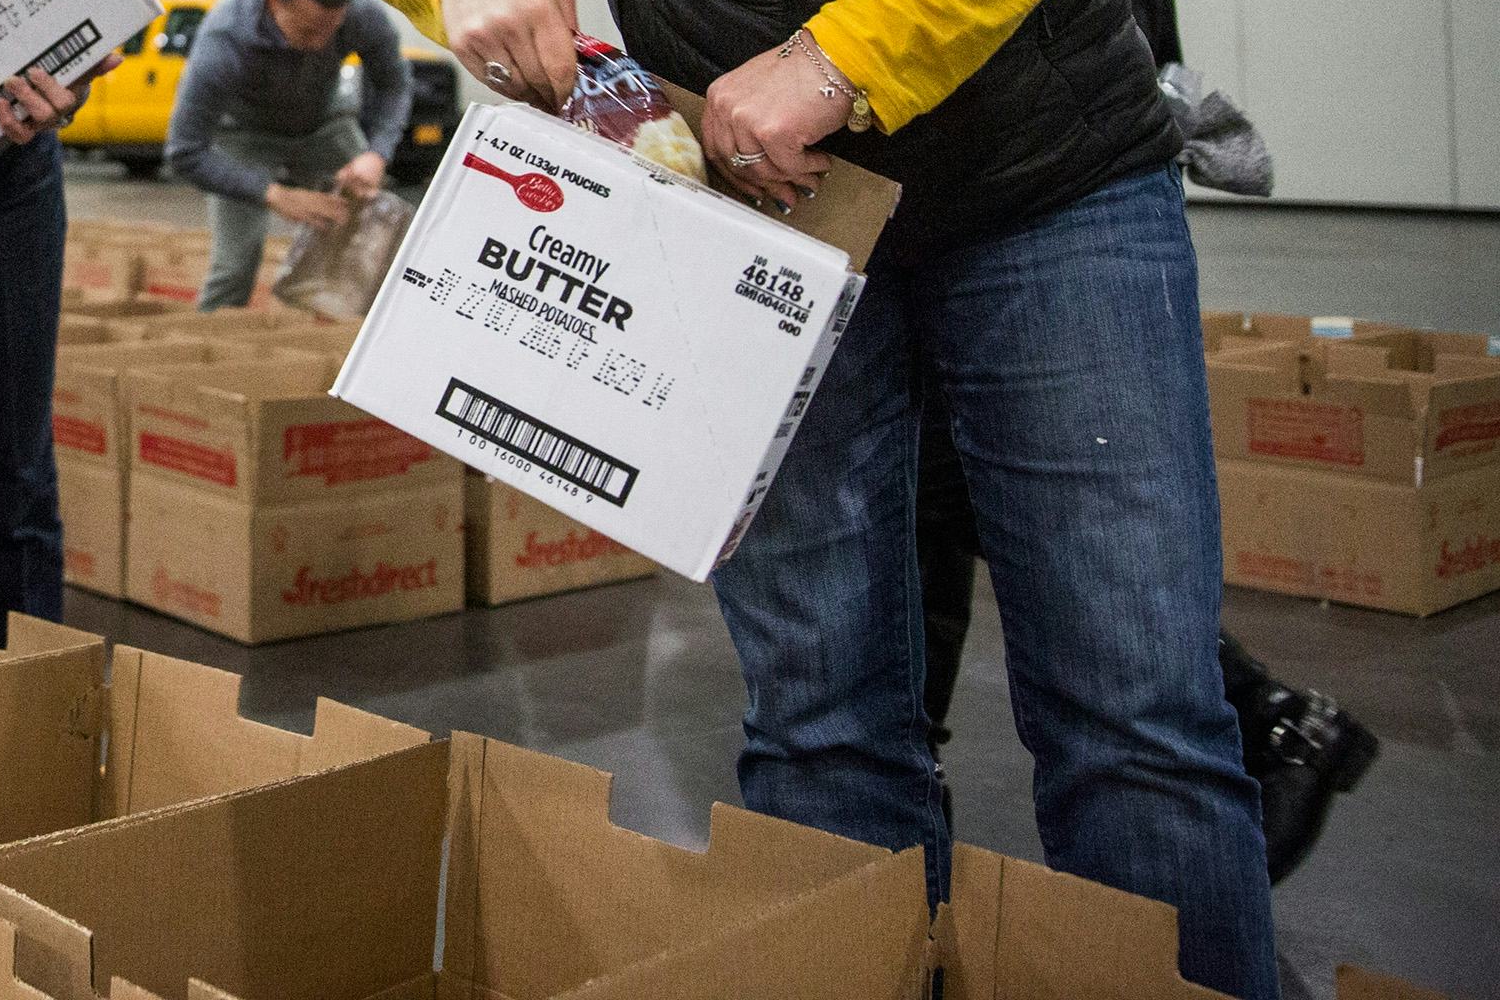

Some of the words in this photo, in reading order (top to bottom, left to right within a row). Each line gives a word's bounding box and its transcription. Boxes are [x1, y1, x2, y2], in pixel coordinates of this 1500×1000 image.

[474, 130, 484, 141] 7
[490, 137, 509, 151] 4.7
[509, 145, 525, 159] OZ
[525, 153, 560, 176] (133g)
[561, 168, 611, 198] POUCHES
[477, 237, 633, 332] BUTTER
[529, 225, 610, 284] Creamy
[743, 264, 804, 301] 46148
[753, 255, 768, 267] 100
[489, 279, 538, 313] MASHED
[538, 302, 594, 341] POTATOES
[778, 320, 801, 337] 000
[457, 429, 463, 438] 1
[469, 434, 487, 450] 00
[494, 447, 532, 473] 16000
[539, 472, 578, 497] 46148
[586, 494, 594, 504] 9
